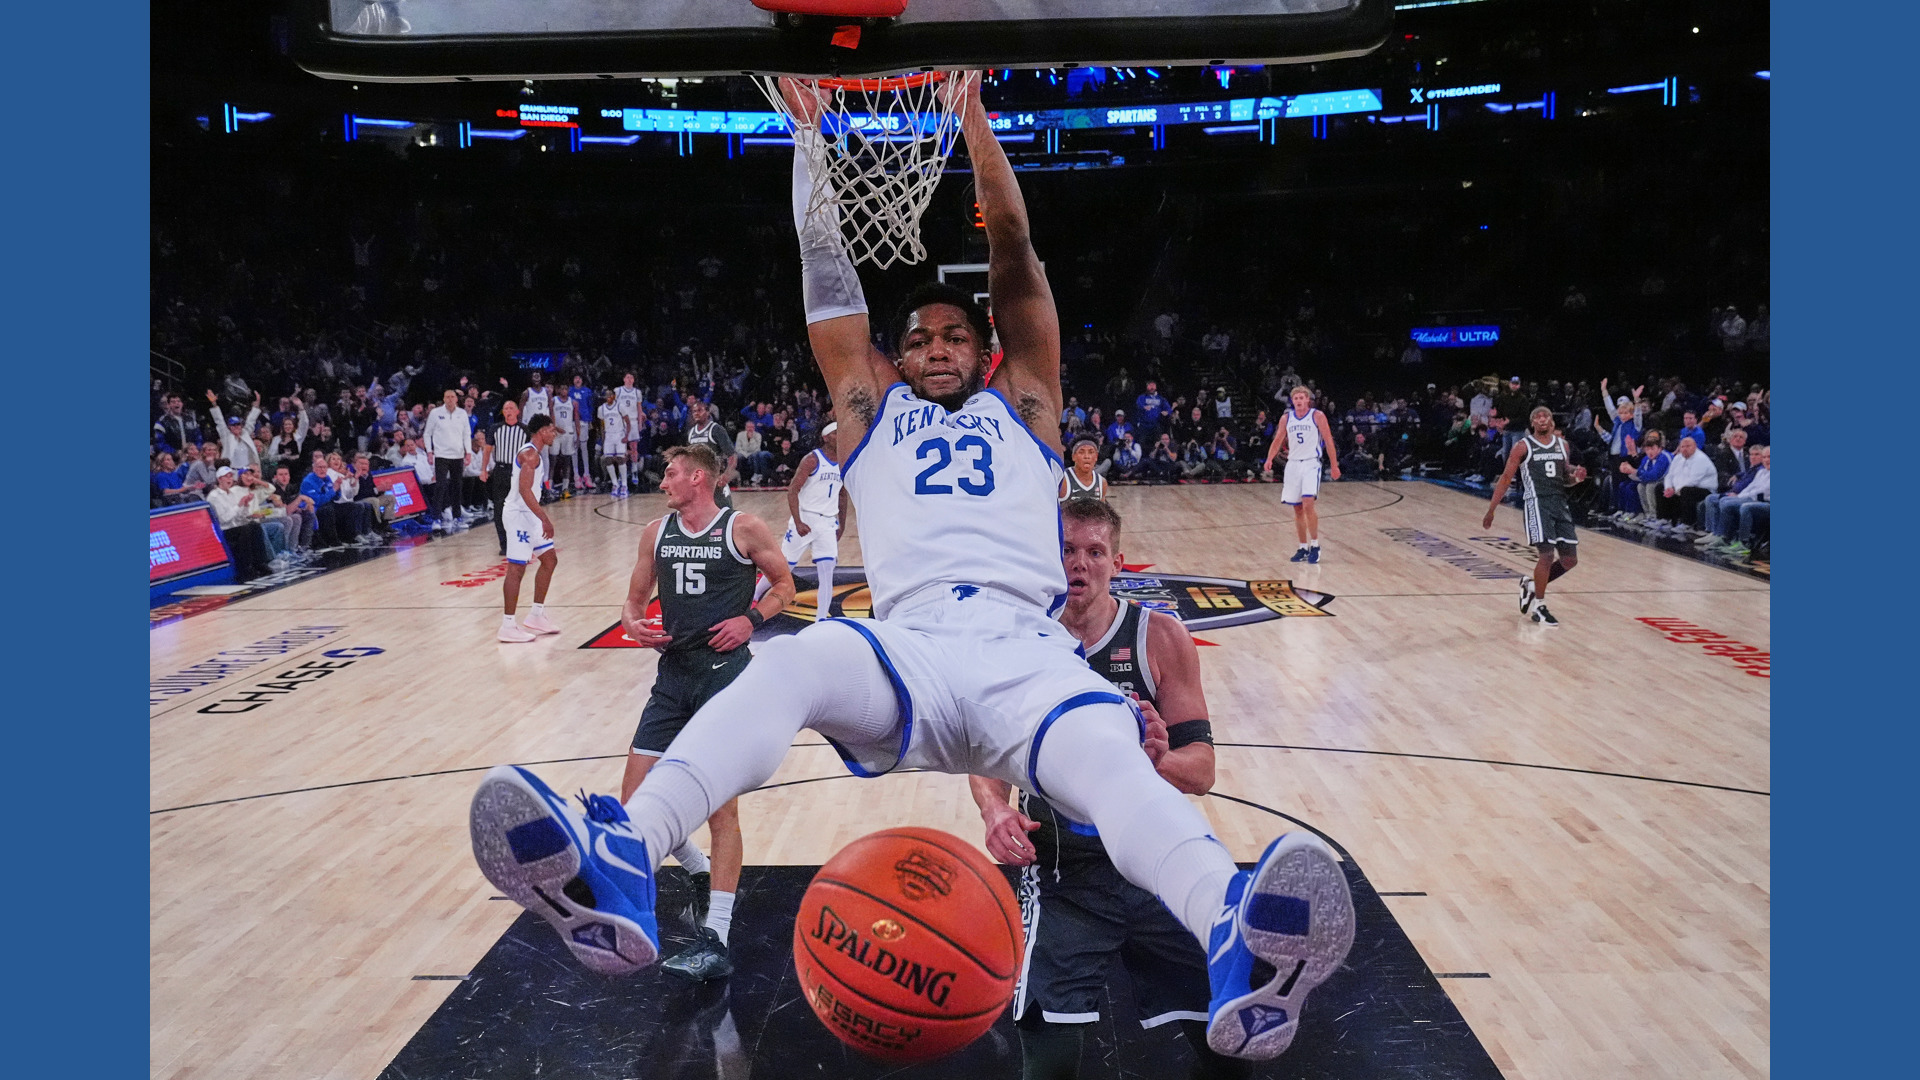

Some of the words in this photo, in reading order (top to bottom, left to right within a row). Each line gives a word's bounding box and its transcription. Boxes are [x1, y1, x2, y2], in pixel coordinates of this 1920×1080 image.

[1427, 83, 1501, 99] @THEGARDEN
[520, 104, 558, 113] GRAMBLING
[559, 107, 579, 115] STATE
[601, 109, 623, 118] 9:00
[1107, 108, 1158, 124] SPARTANS
[520, 112, 539, 121] SAN
[540, 113, 568, 122] DIEGO
[1018, 113, 1035, 126] 14
[1460, 331, 1499, 341] ULTRA
[537, 402, 543, 410] 3
[609, 418, 615, 426] 2
[893, 404, 1005, 447] KENCKY
[1296, 432, 1304, 444] 5
[1533, 453, 1563, 461] SPARTANS
[915, 434, 996, 497] 23
[1544, 461, 1556, 478] 9
[828, 483, 833, 498] 1
[660, 545, 722, 559] SPARTANS
[672, 562, 706, 594] 15
[197, 660, 357, 714] CHASE
[811, 904, 957, 1009] SPALDING
